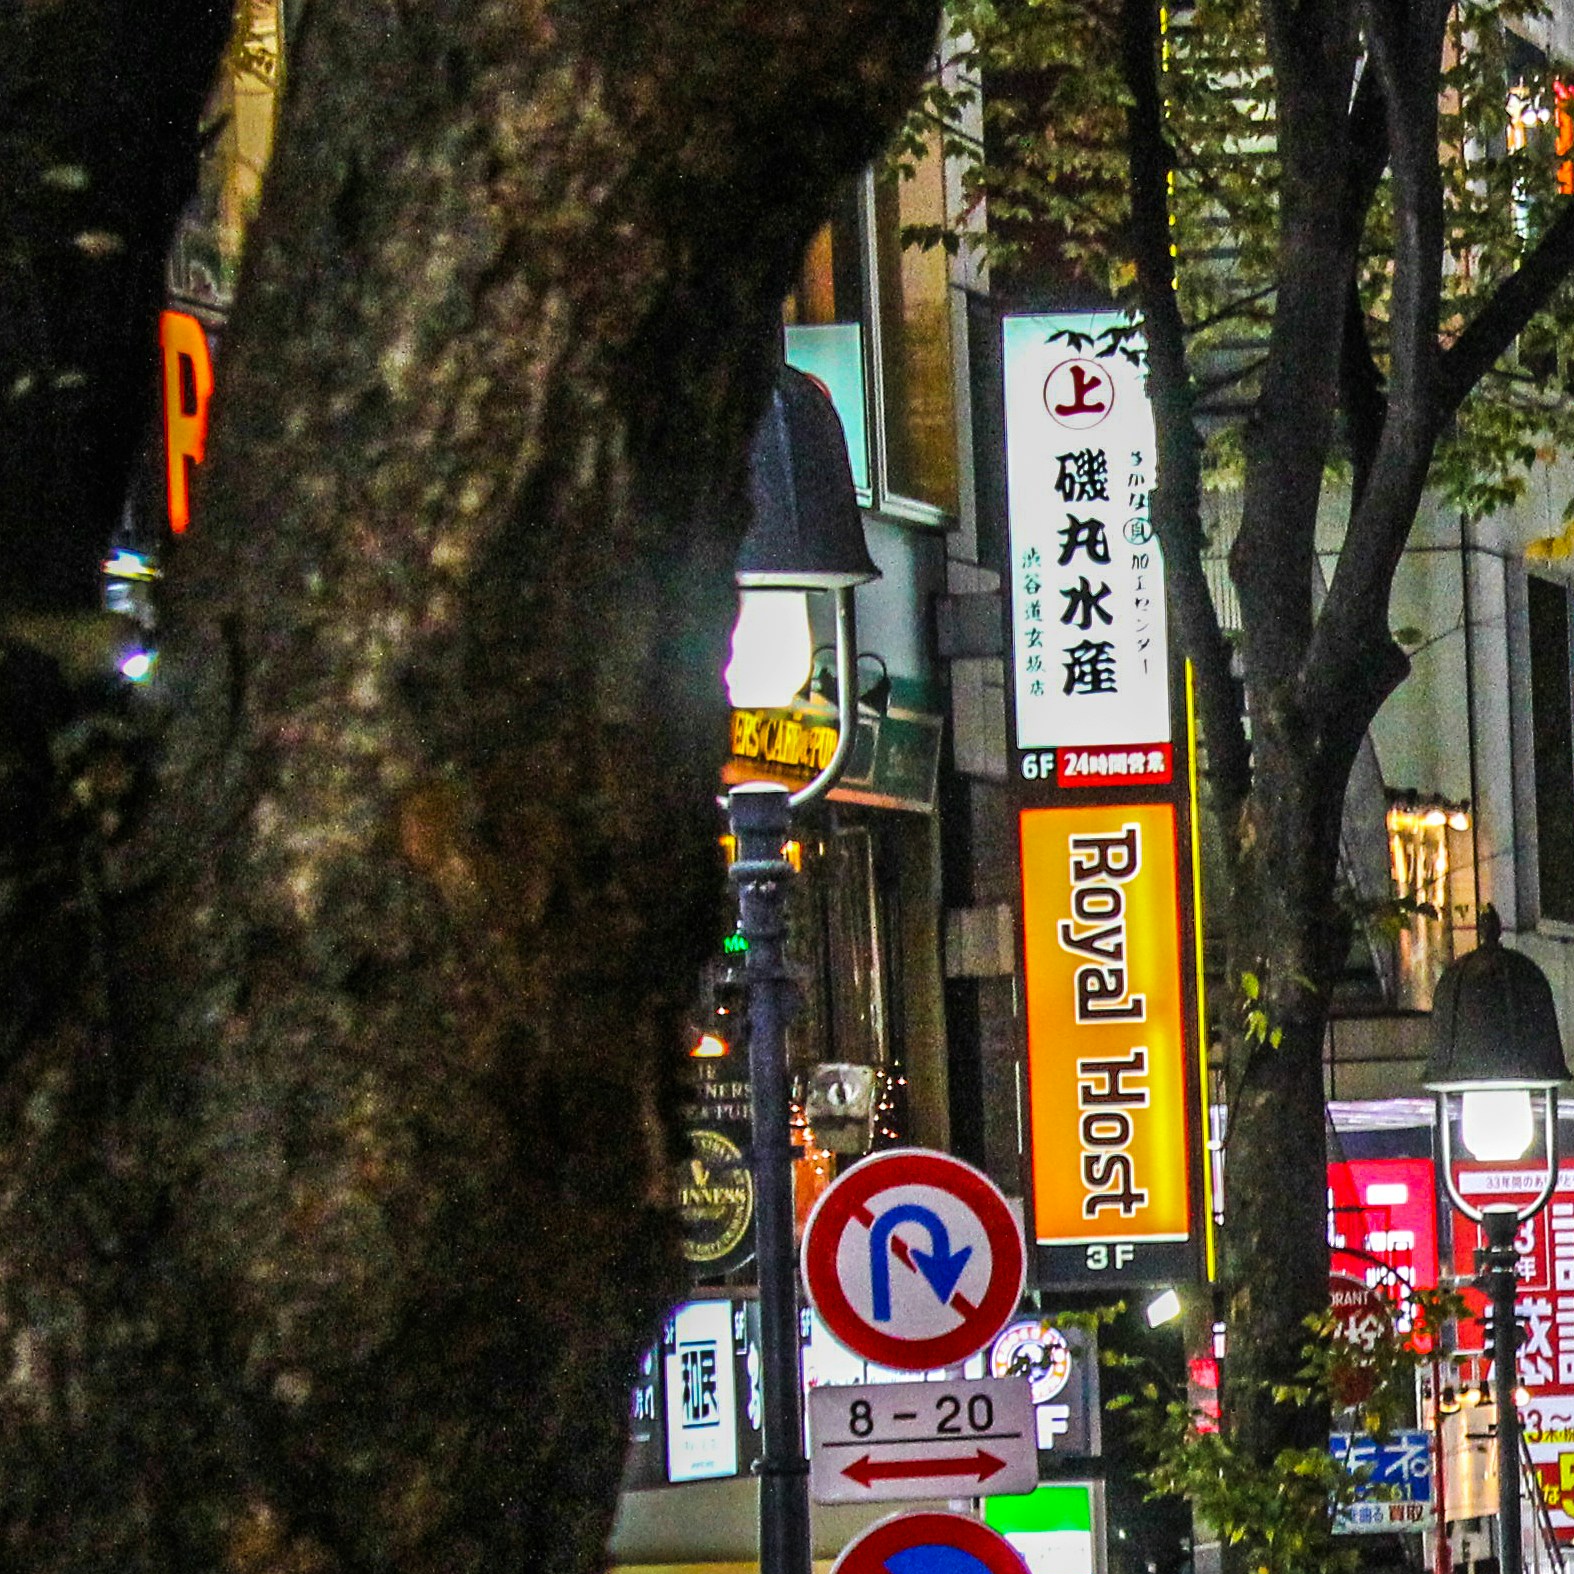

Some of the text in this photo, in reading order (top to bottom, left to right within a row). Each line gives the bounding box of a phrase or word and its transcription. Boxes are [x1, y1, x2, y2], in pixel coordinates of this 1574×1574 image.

[1056, 366, 1105, 417] 上
[1055, 447, 1119, 697] 磯丸水産
[1022, 545, 1045, 699] 渋谷道玄坂店
[1021, 752, 1054, 781] 6F
[1063, 748, 1166, 777] 24時間営業
[1058, 823, 1152, 1222] Royal Host
[680, 1188, 747, 1206] INNESS
[1086, 1243, 1137, 1272] 3F
